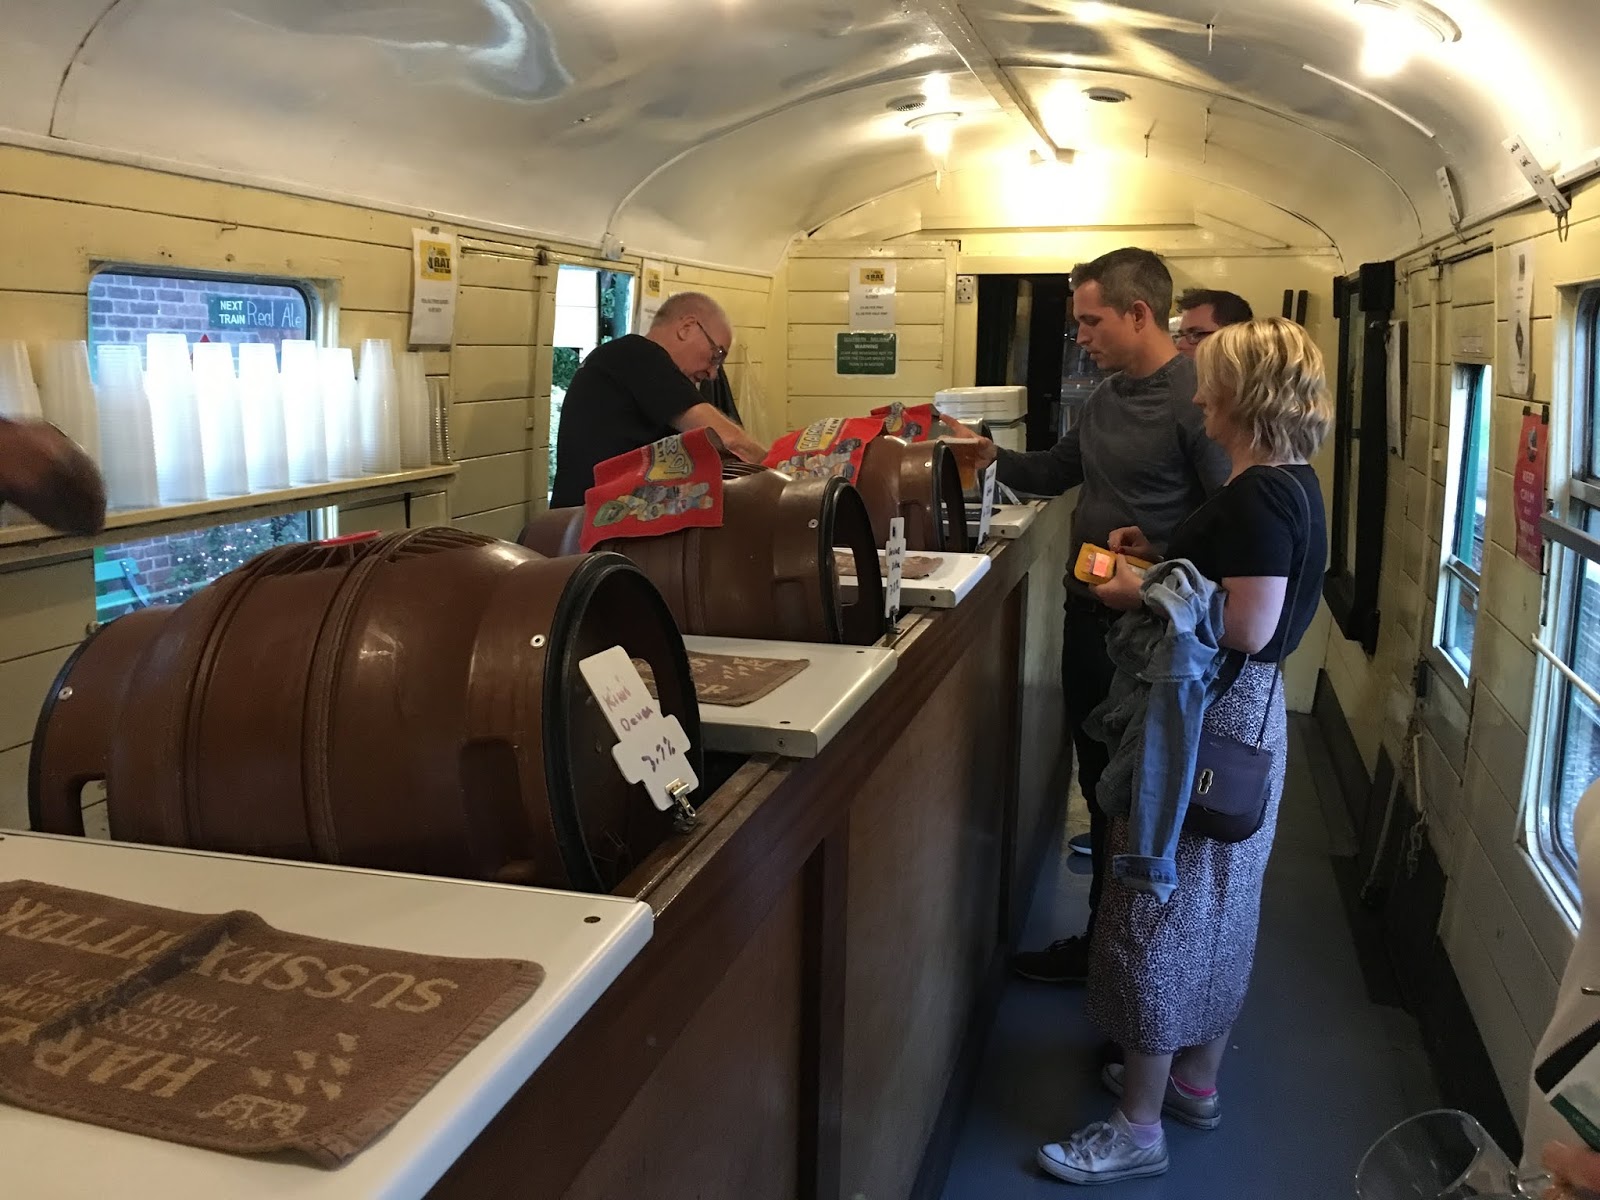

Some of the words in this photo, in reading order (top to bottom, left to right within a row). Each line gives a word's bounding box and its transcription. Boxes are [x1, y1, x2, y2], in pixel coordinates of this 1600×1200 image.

[434, 257, 451, 269] RAT
[220, 301, 243, 311] NEXT
[219, 314, 246, 325] TRAIN
[247, 300, 275, 327] Real
[281, 302, 303, 328] Ale
[190, 932, 459, 1013] SUSSEX
